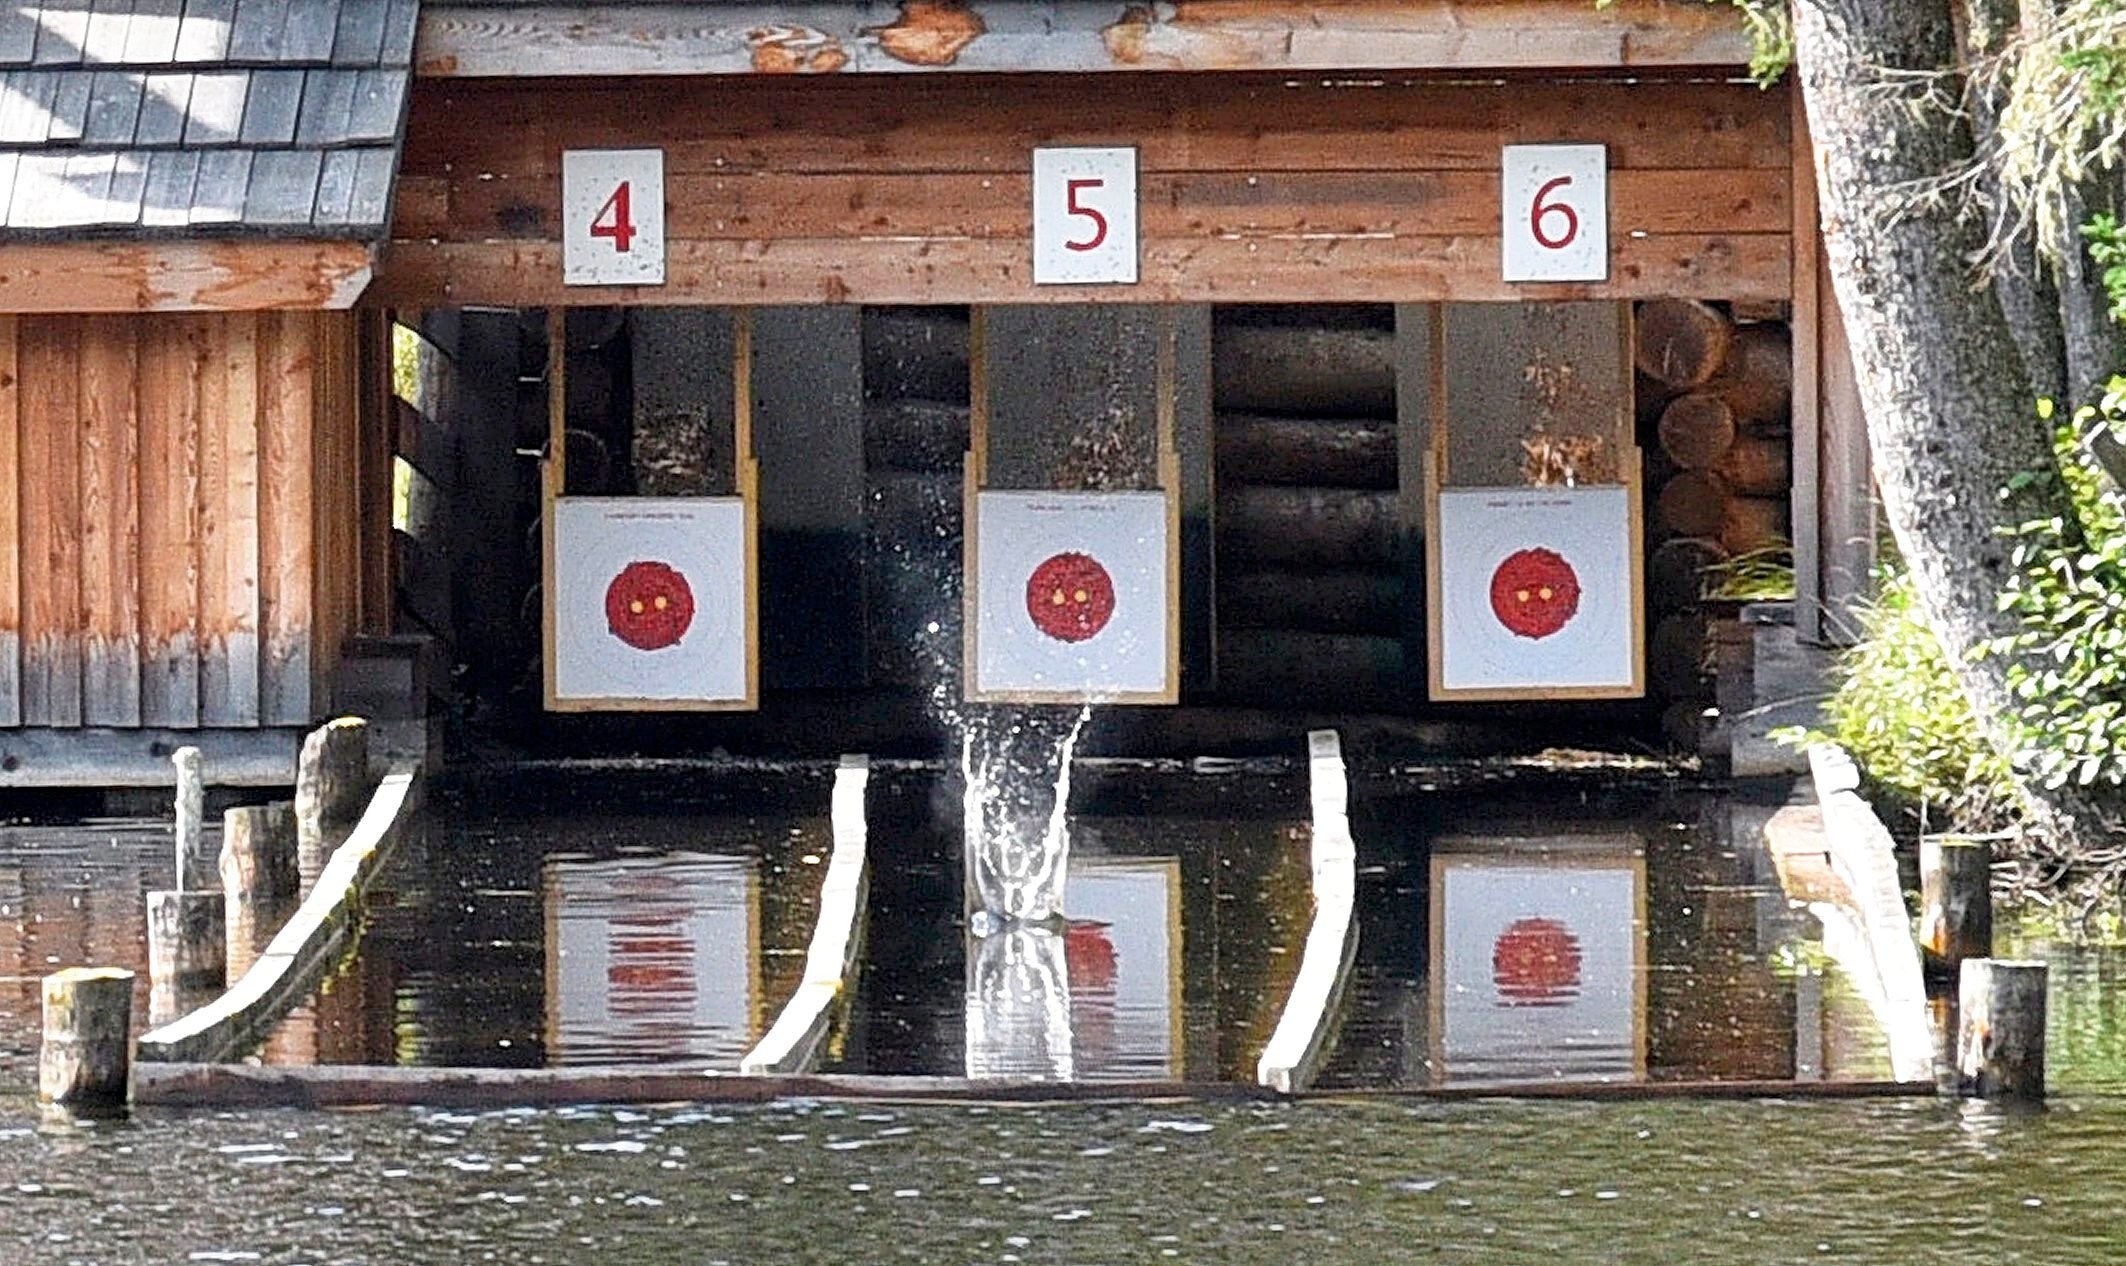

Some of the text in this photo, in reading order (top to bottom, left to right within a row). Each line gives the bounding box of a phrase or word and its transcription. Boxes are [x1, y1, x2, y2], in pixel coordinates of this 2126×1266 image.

[590, 181, 637, 252] 4
[1065, 179, 1108, 251] 5
[1530, 175, 1579, 250] 6
